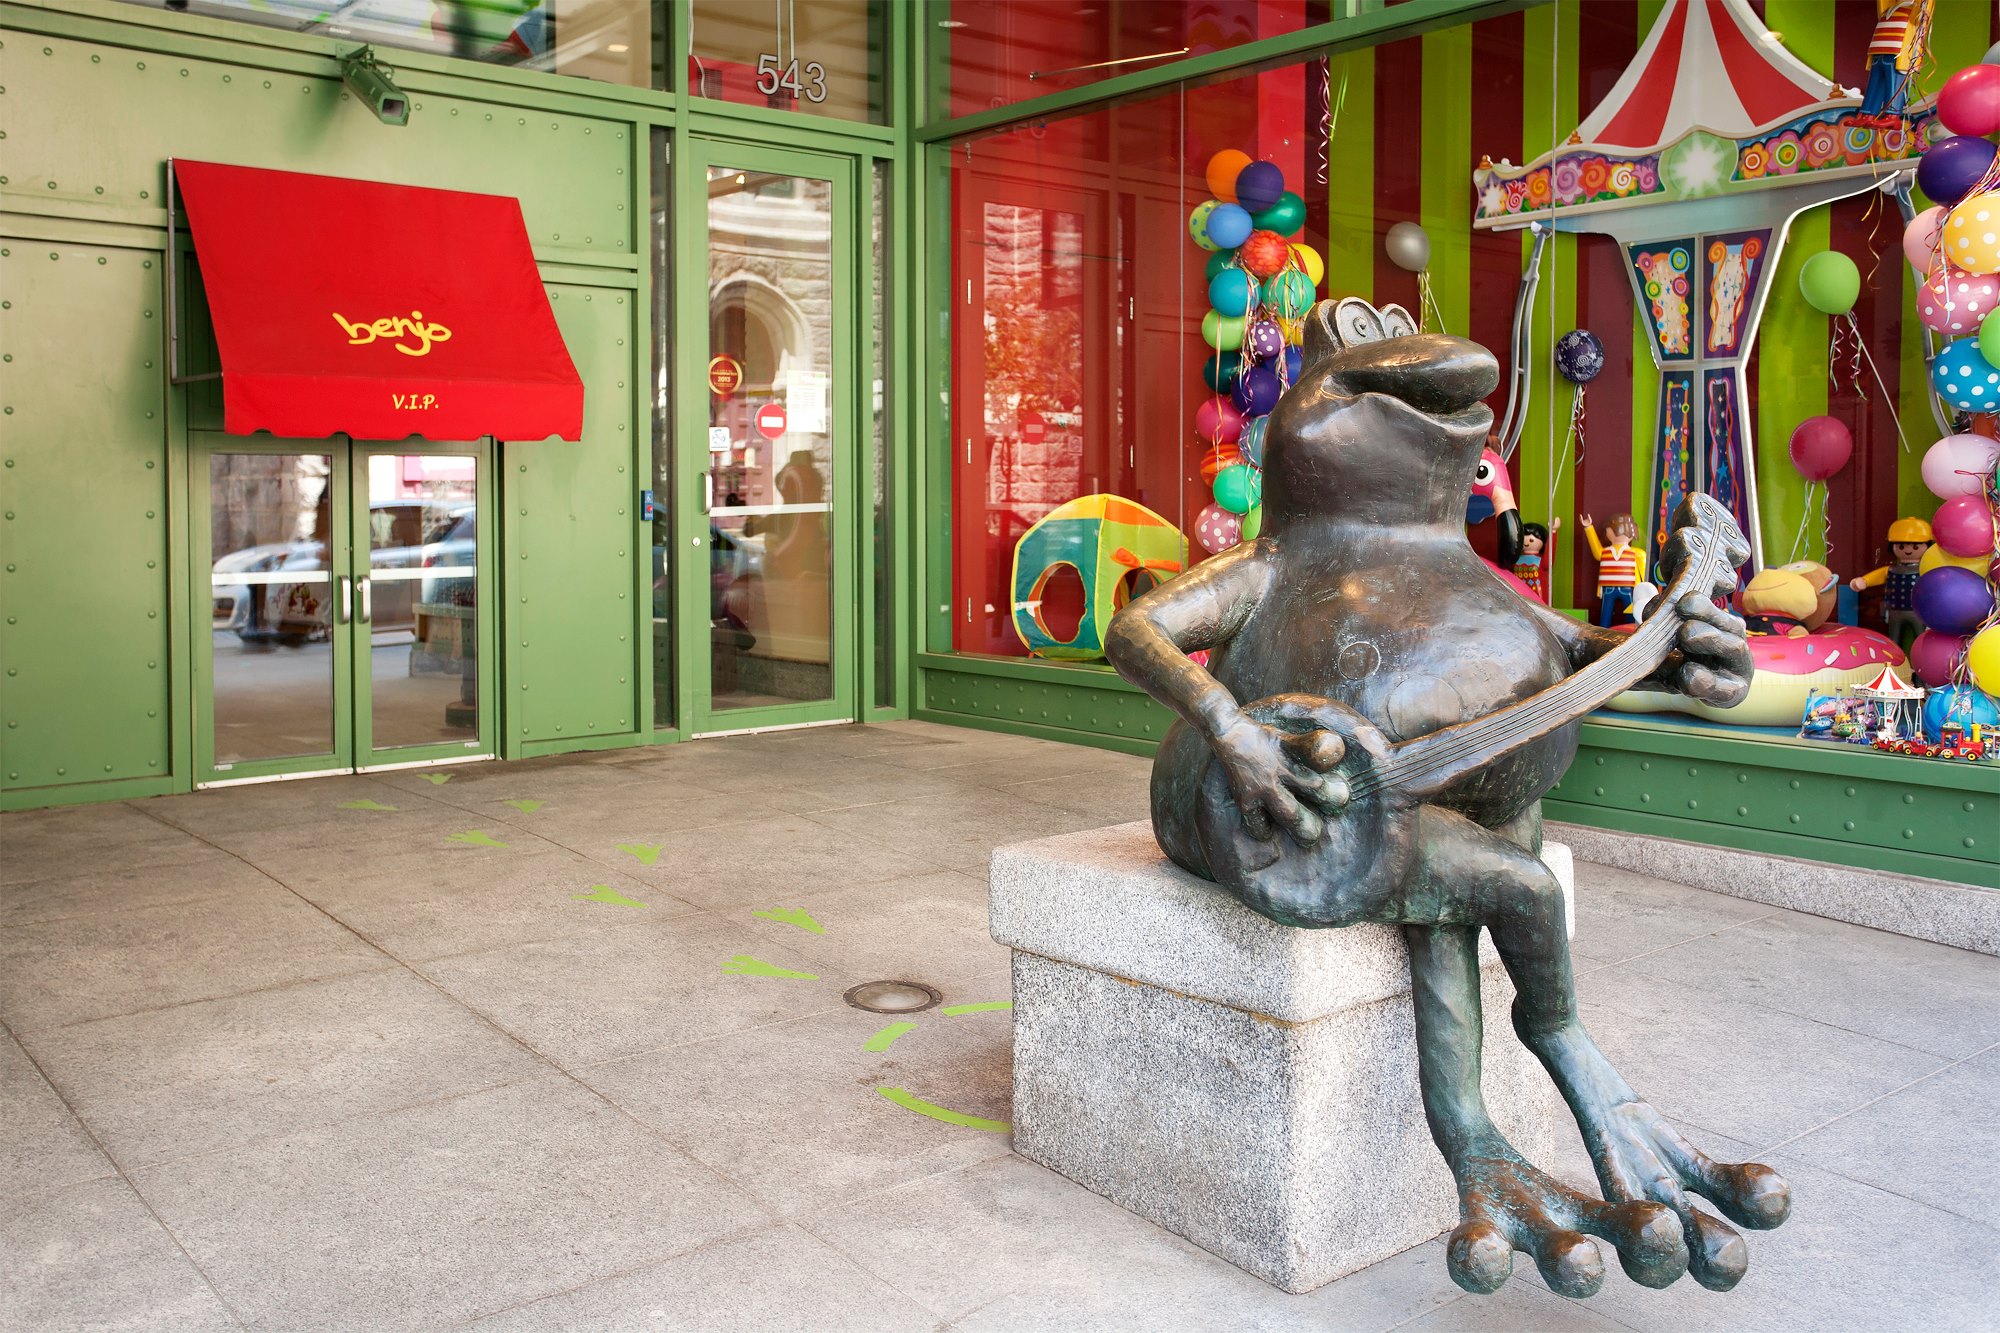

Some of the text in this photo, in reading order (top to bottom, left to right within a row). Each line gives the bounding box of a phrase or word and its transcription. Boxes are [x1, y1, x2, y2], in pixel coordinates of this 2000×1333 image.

[756, 53, 827, 103] 543
[332, 310, 452, 357] benjo
[392, 393, 439, 410] V.I.P.
